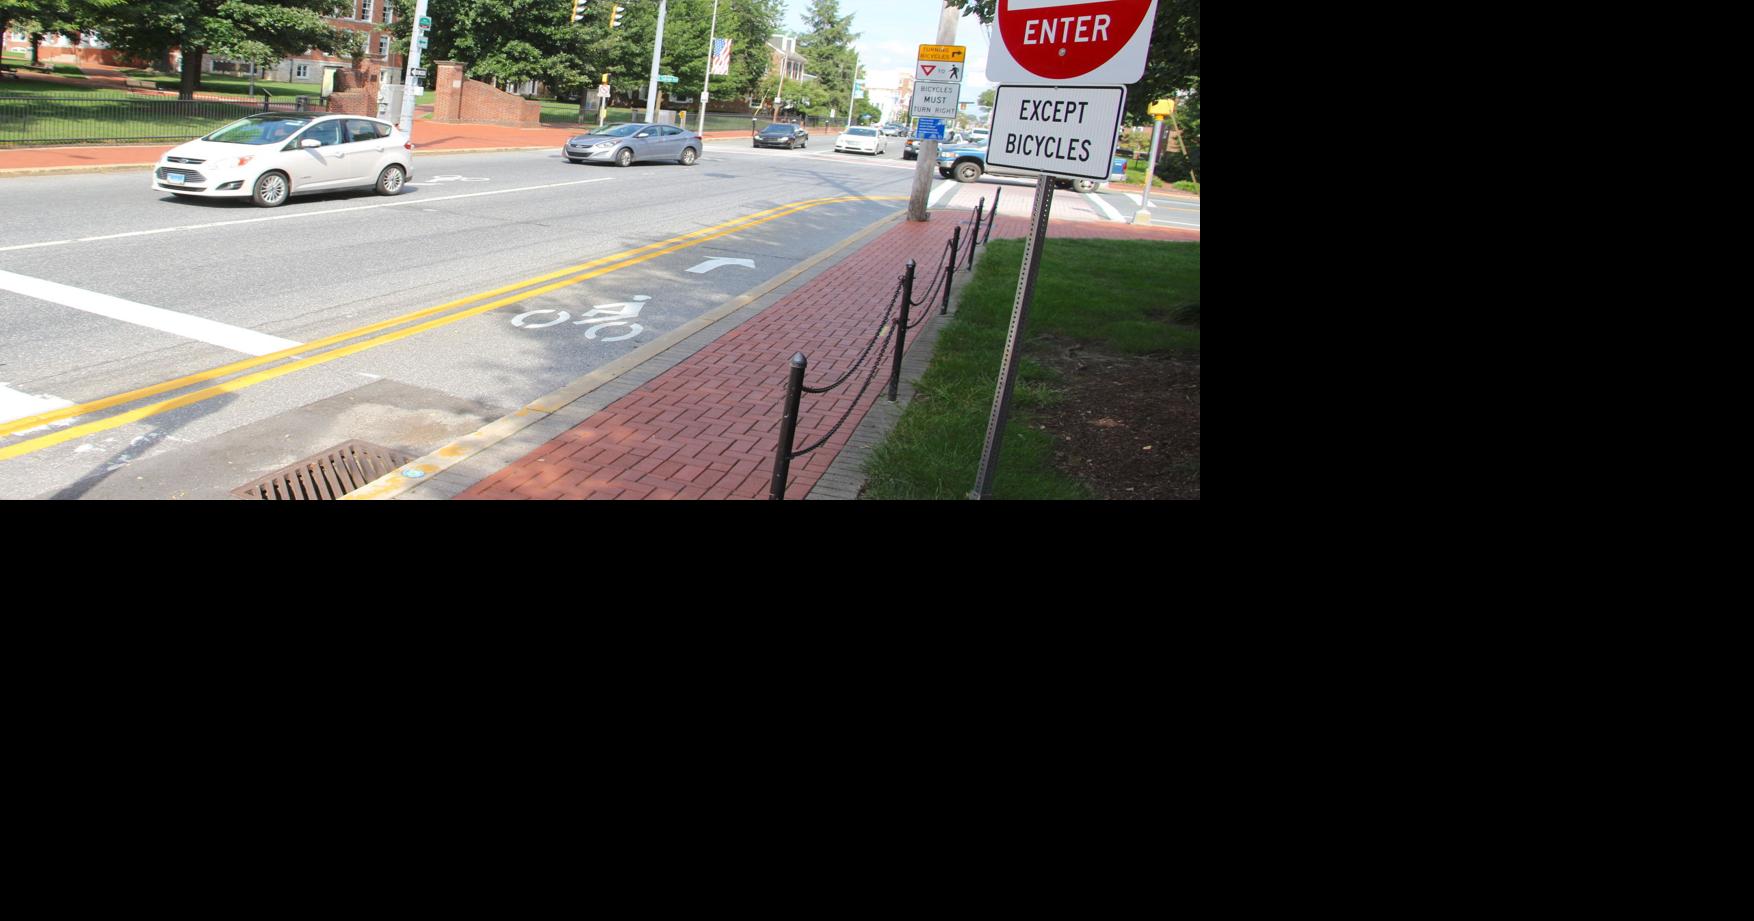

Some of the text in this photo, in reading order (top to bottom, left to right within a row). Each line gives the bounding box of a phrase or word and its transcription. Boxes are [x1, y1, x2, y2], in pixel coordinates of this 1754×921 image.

[1023, 14, 1111, 45] ENTER
[920, 86, 953, 94] BICYCLES
[923, 96, 946, 104] MUST
[1019, 99, 1088, 124] EXCEPT
[1005, 133, 1092, 162] BICYCLES
